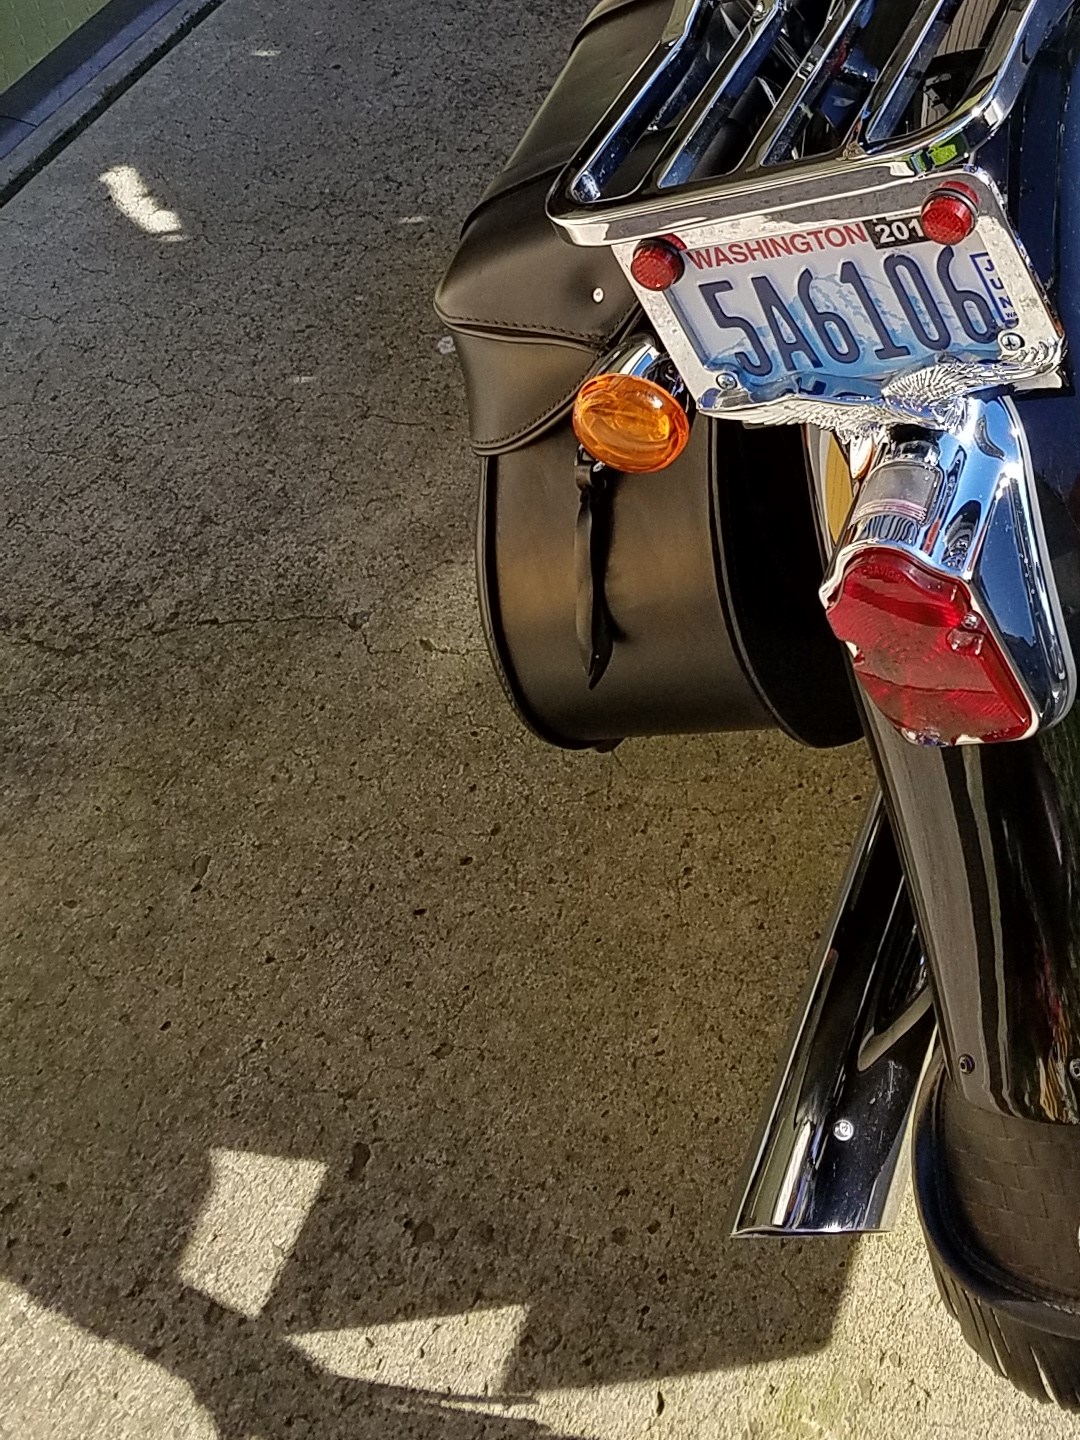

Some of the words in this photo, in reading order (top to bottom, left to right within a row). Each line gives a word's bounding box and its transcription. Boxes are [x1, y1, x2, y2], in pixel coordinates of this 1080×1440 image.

[686, 223, 868, 270] WASHINGTON
[874, 218, 926, 244] 201
[698, 244, 998, 378] 5A6106
